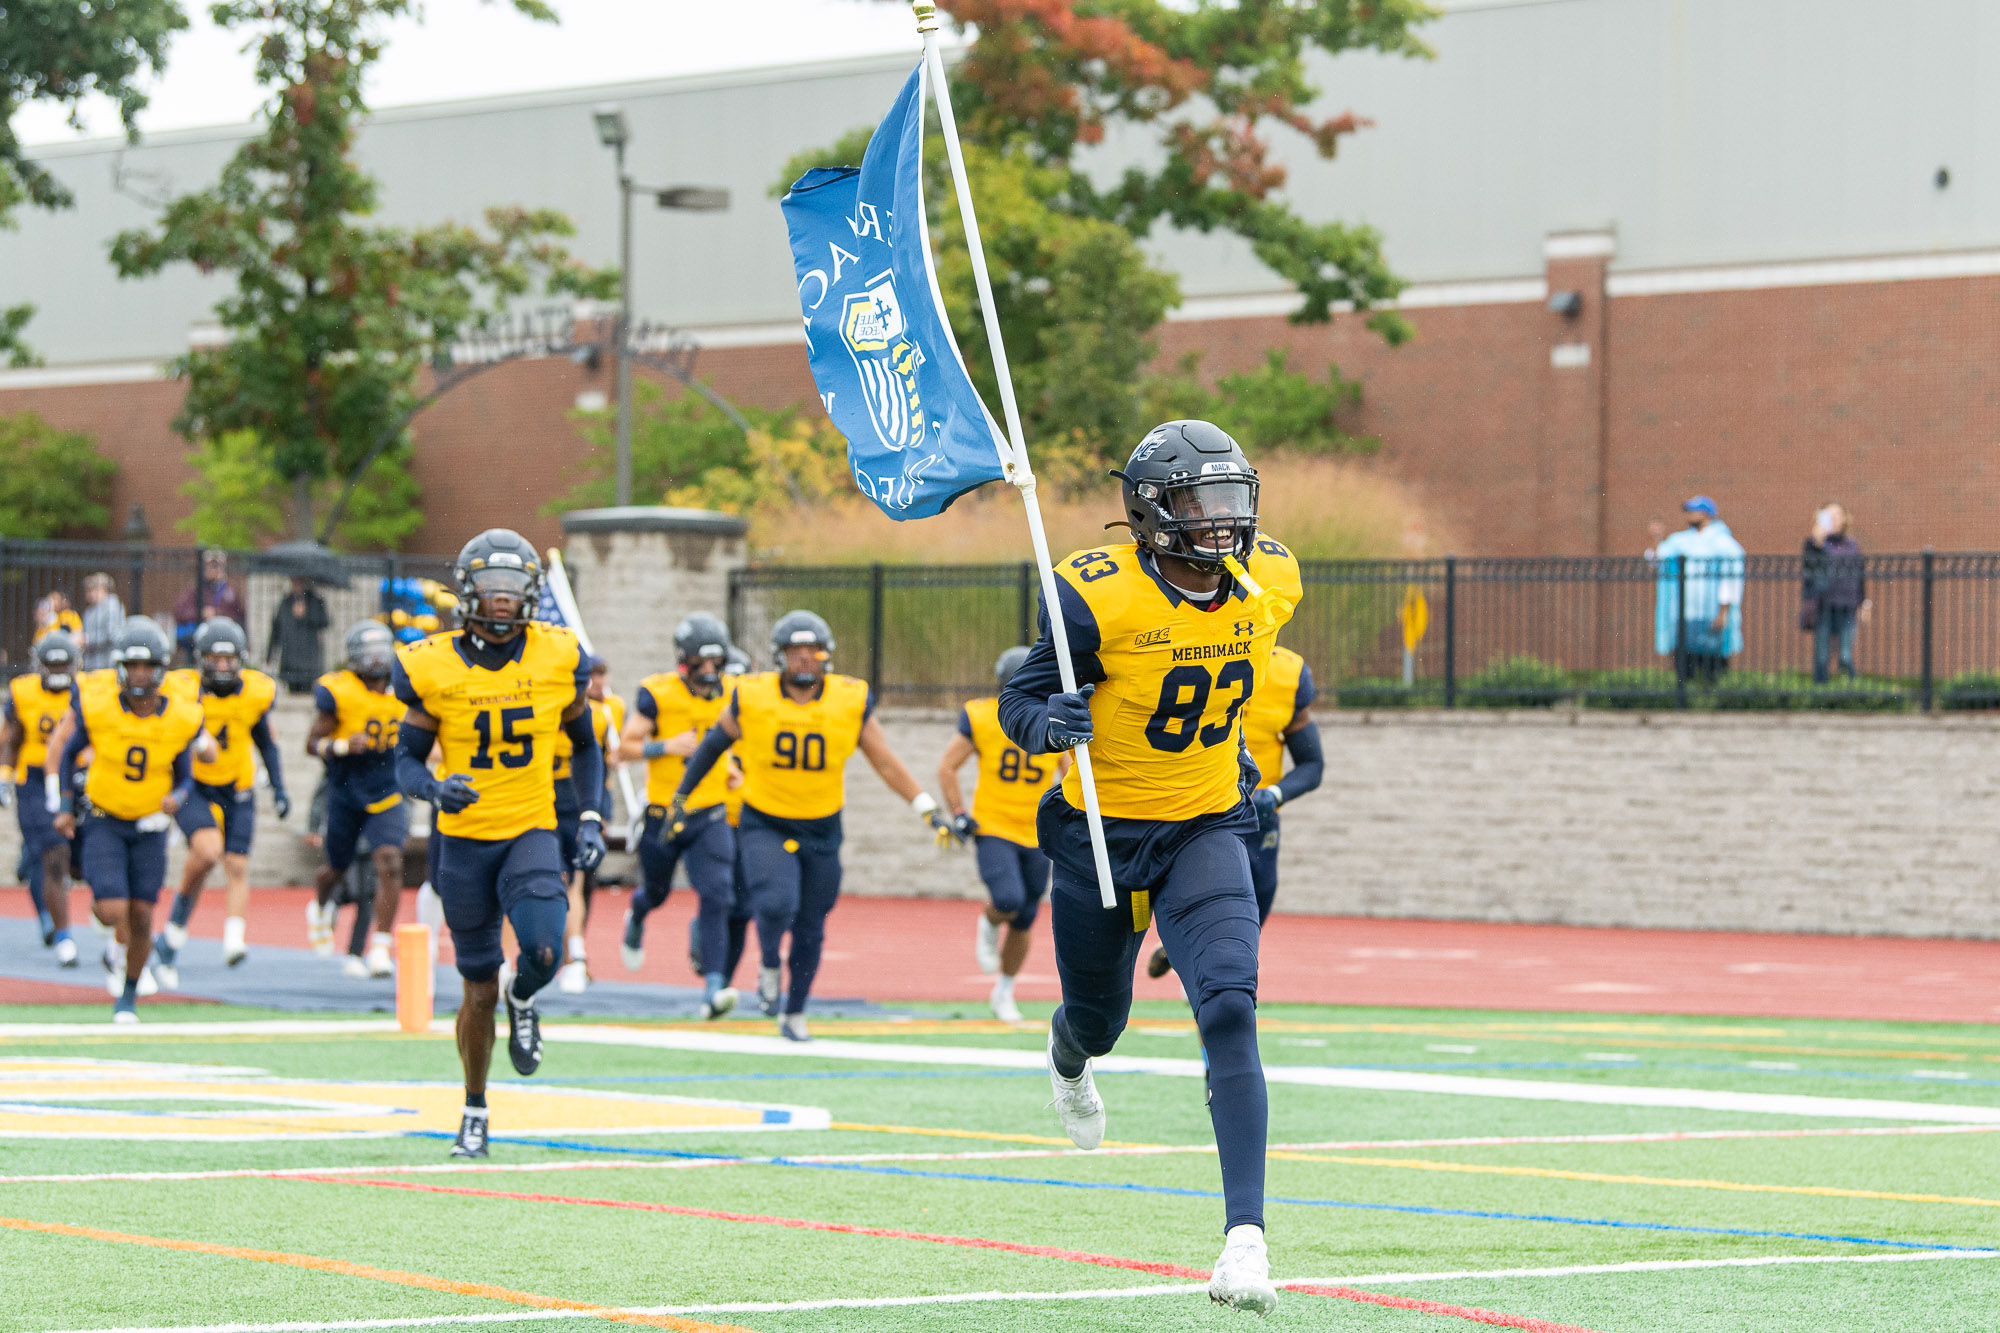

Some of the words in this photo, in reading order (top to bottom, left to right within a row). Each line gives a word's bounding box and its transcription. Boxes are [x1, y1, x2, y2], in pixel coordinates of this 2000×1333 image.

[1211, 463, 1231, 472] MACK
[1071, 552, 1119, 582] 83
[1134, 627, 1170, 646] NEC
[1172, 641, 1252, 661] MERRIMACK
[1144, 658, 1255, 753] 83
[470, 706, 535, 770] 15
[772, 731, 826, 771] 90
[125, 745, 148, 782] 9
[1000, 748, 1044, 784] 85
